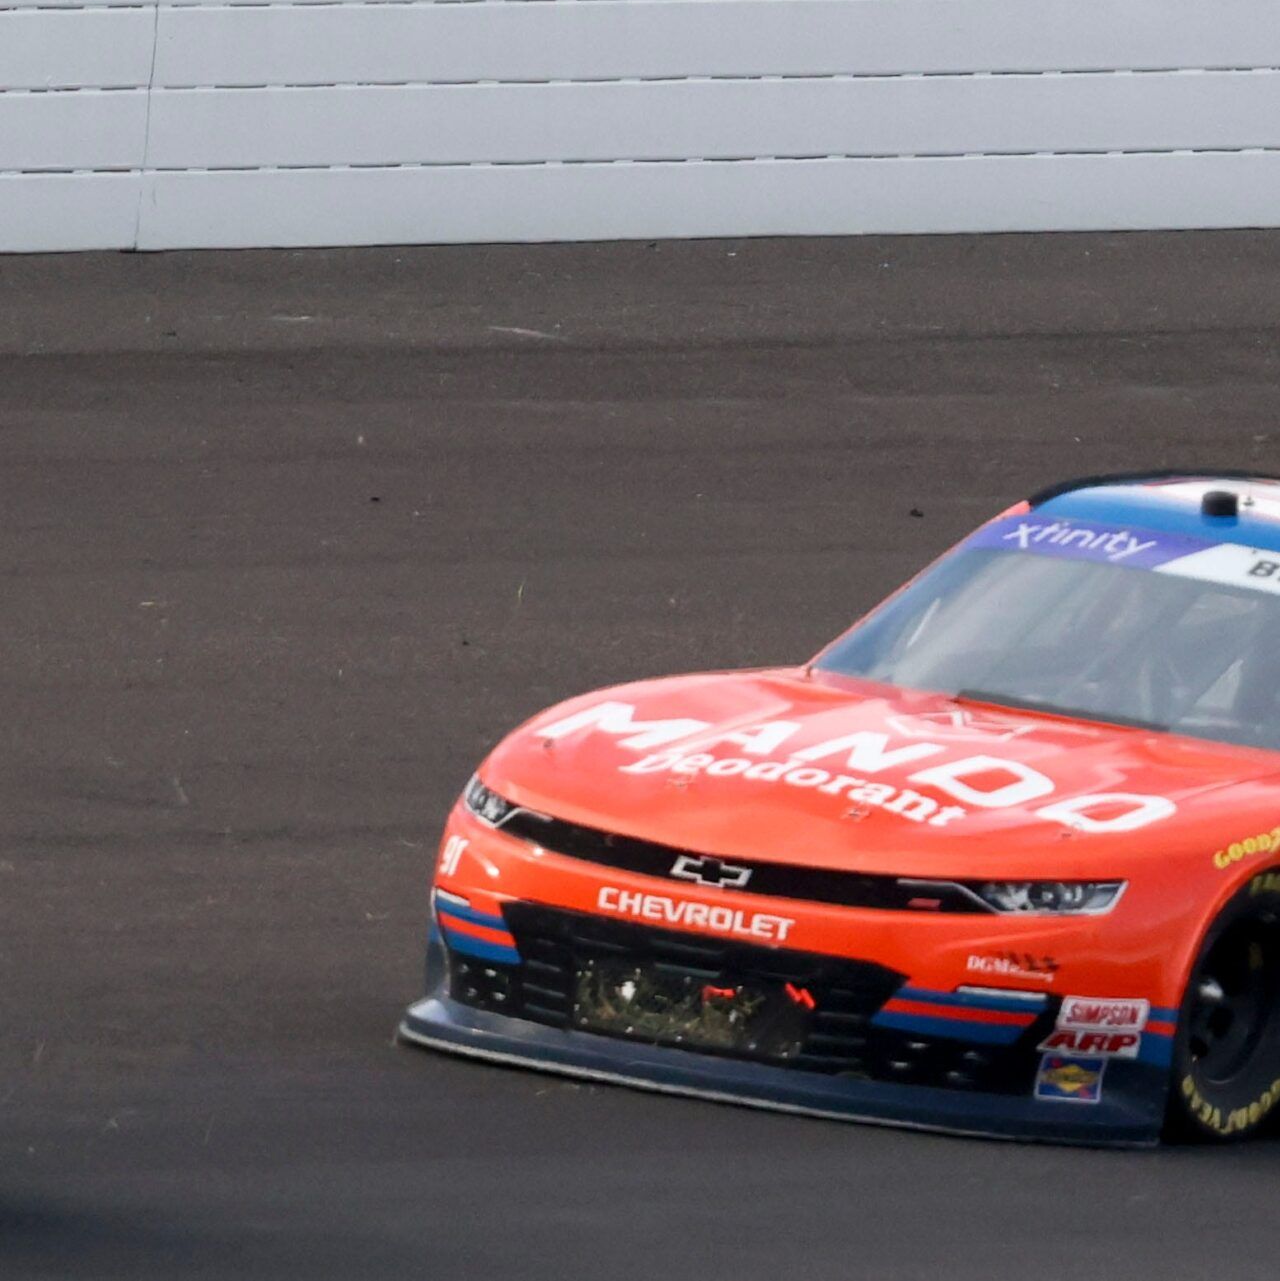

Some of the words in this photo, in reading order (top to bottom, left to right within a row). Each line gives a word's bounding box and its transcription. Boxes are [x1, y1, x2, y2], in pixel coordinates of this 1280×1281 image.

[1002, 519, 1158, 561] xfinity
[533, 700, 1178, 833] MANDO
[618, 750, 973, 827] Deodorant
[438, 834, 471, 877] 91
[597, 886, 796, 943] CHEVROLET
[1046, 1031, 1137, 1052] ARP
